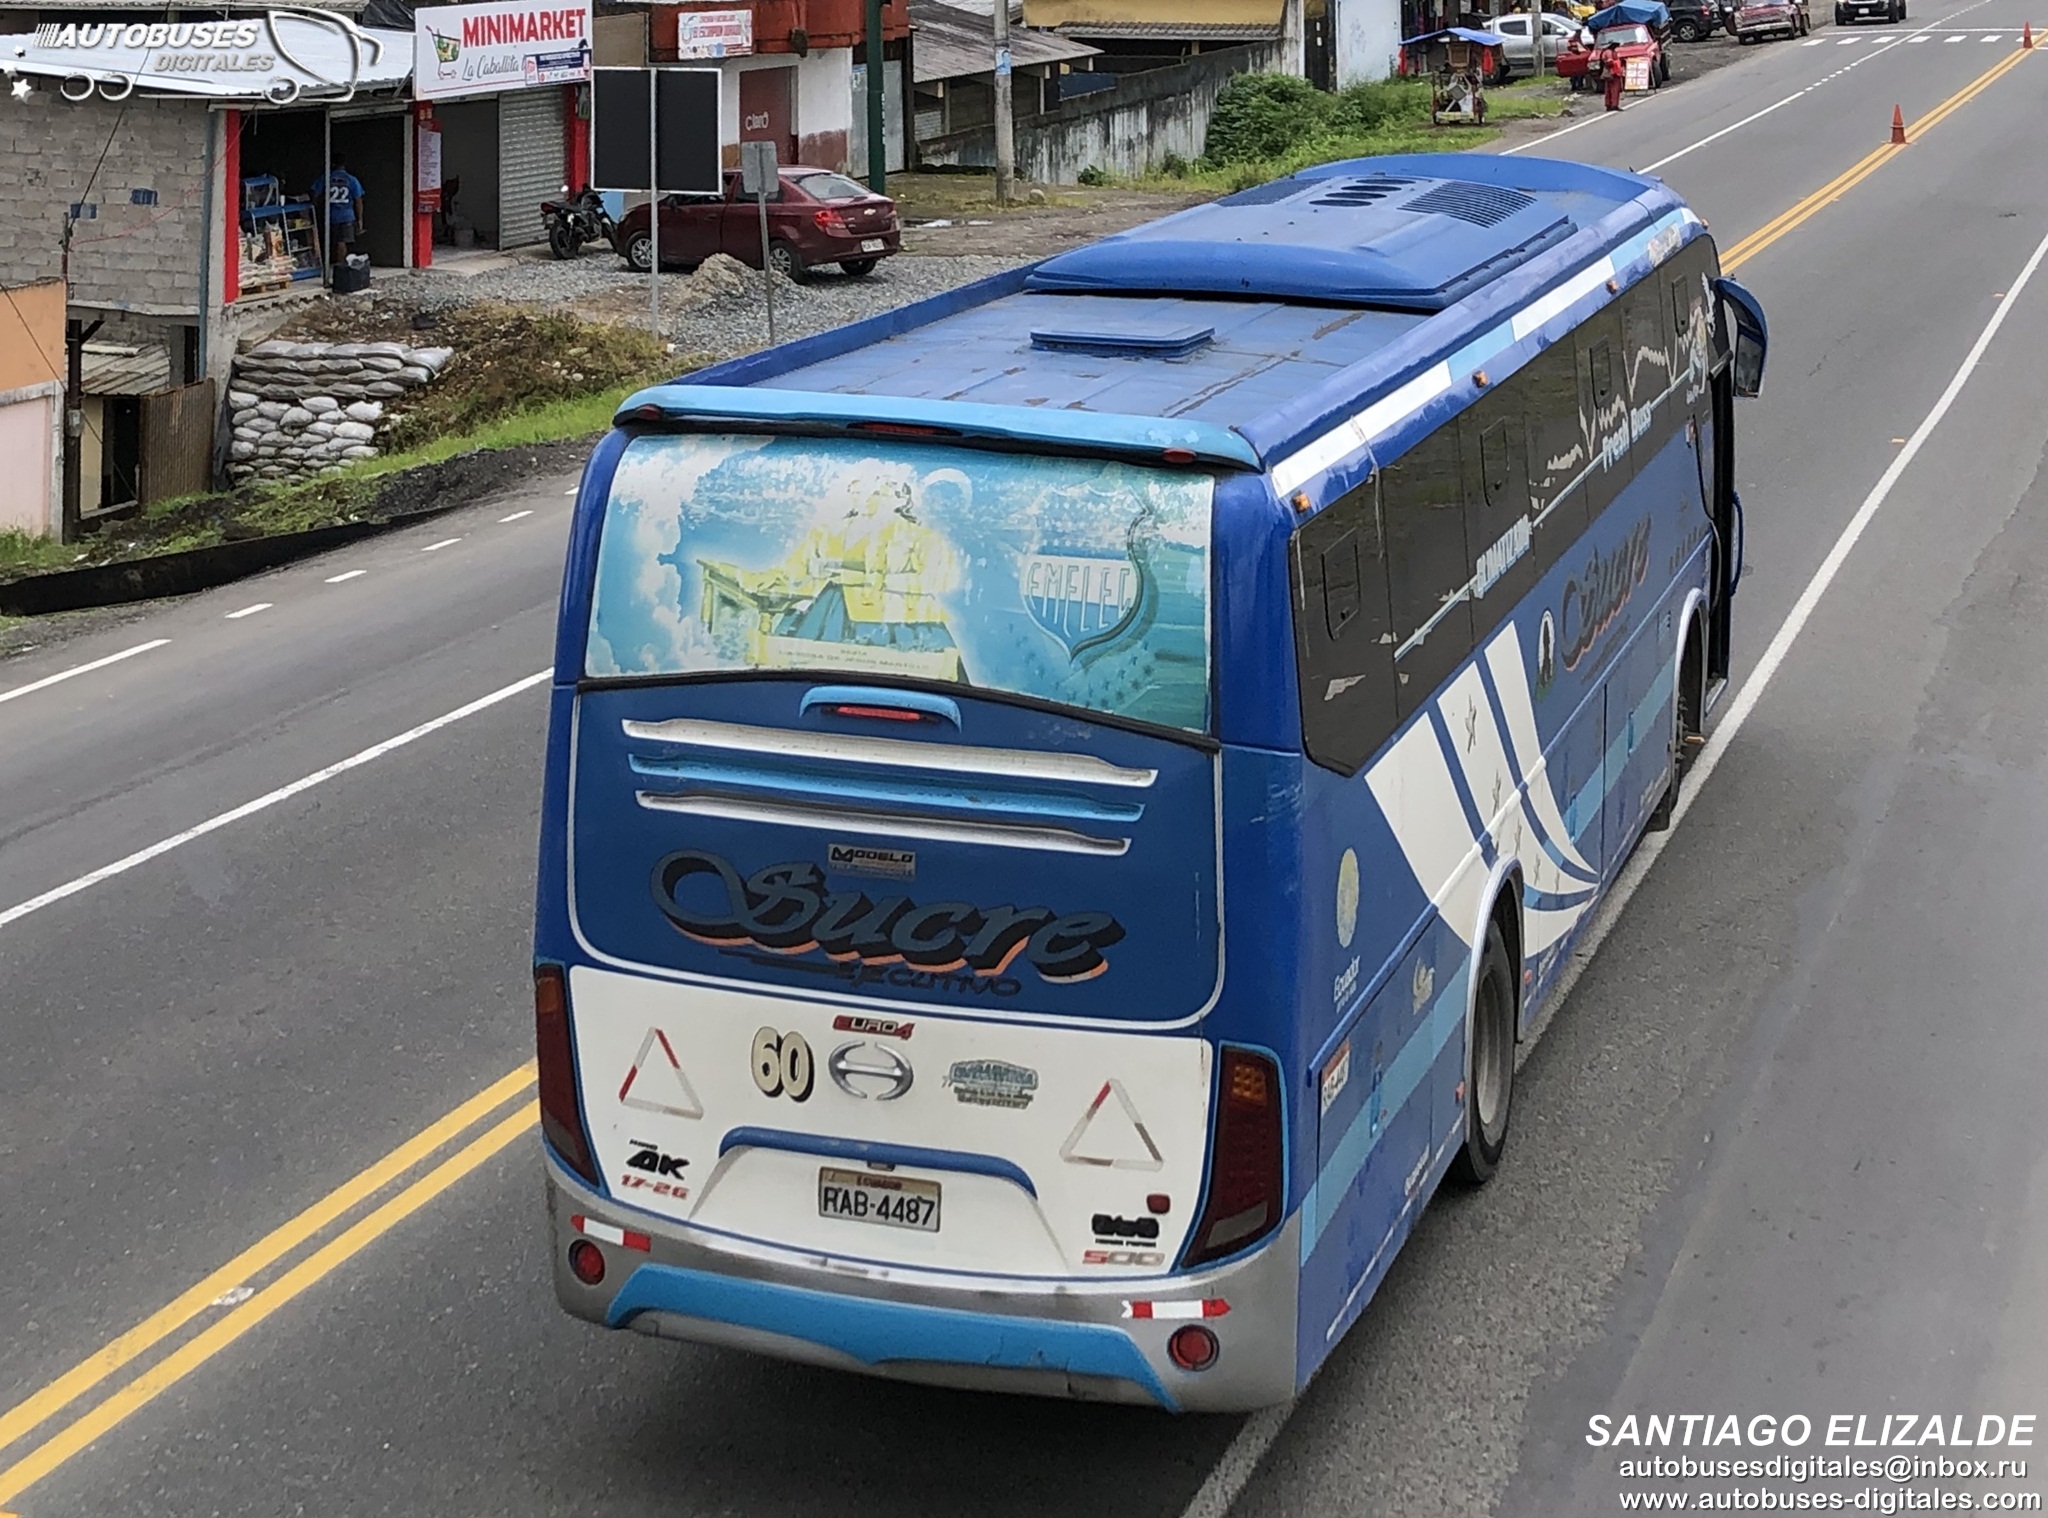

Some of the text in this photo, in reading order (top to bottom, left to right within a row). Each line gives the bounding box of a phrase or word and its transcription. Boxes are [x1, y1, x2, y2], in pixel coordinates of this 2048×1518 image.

[463, 9, 586, 48] MINIMARKET
[462, 58, 474, 81] La
[330, 186, 349, 203] 22
[1027, 562, 1131, 638] EMELEC
[831, 846, 914, 863] MODELO
[650, 848, 1126, 983] Sucre
[751, 1026, 815, 1103] 60
[823, 1186, 935, 1225] RAB-4487
[1082, 1250, 1165, 1266] 500
